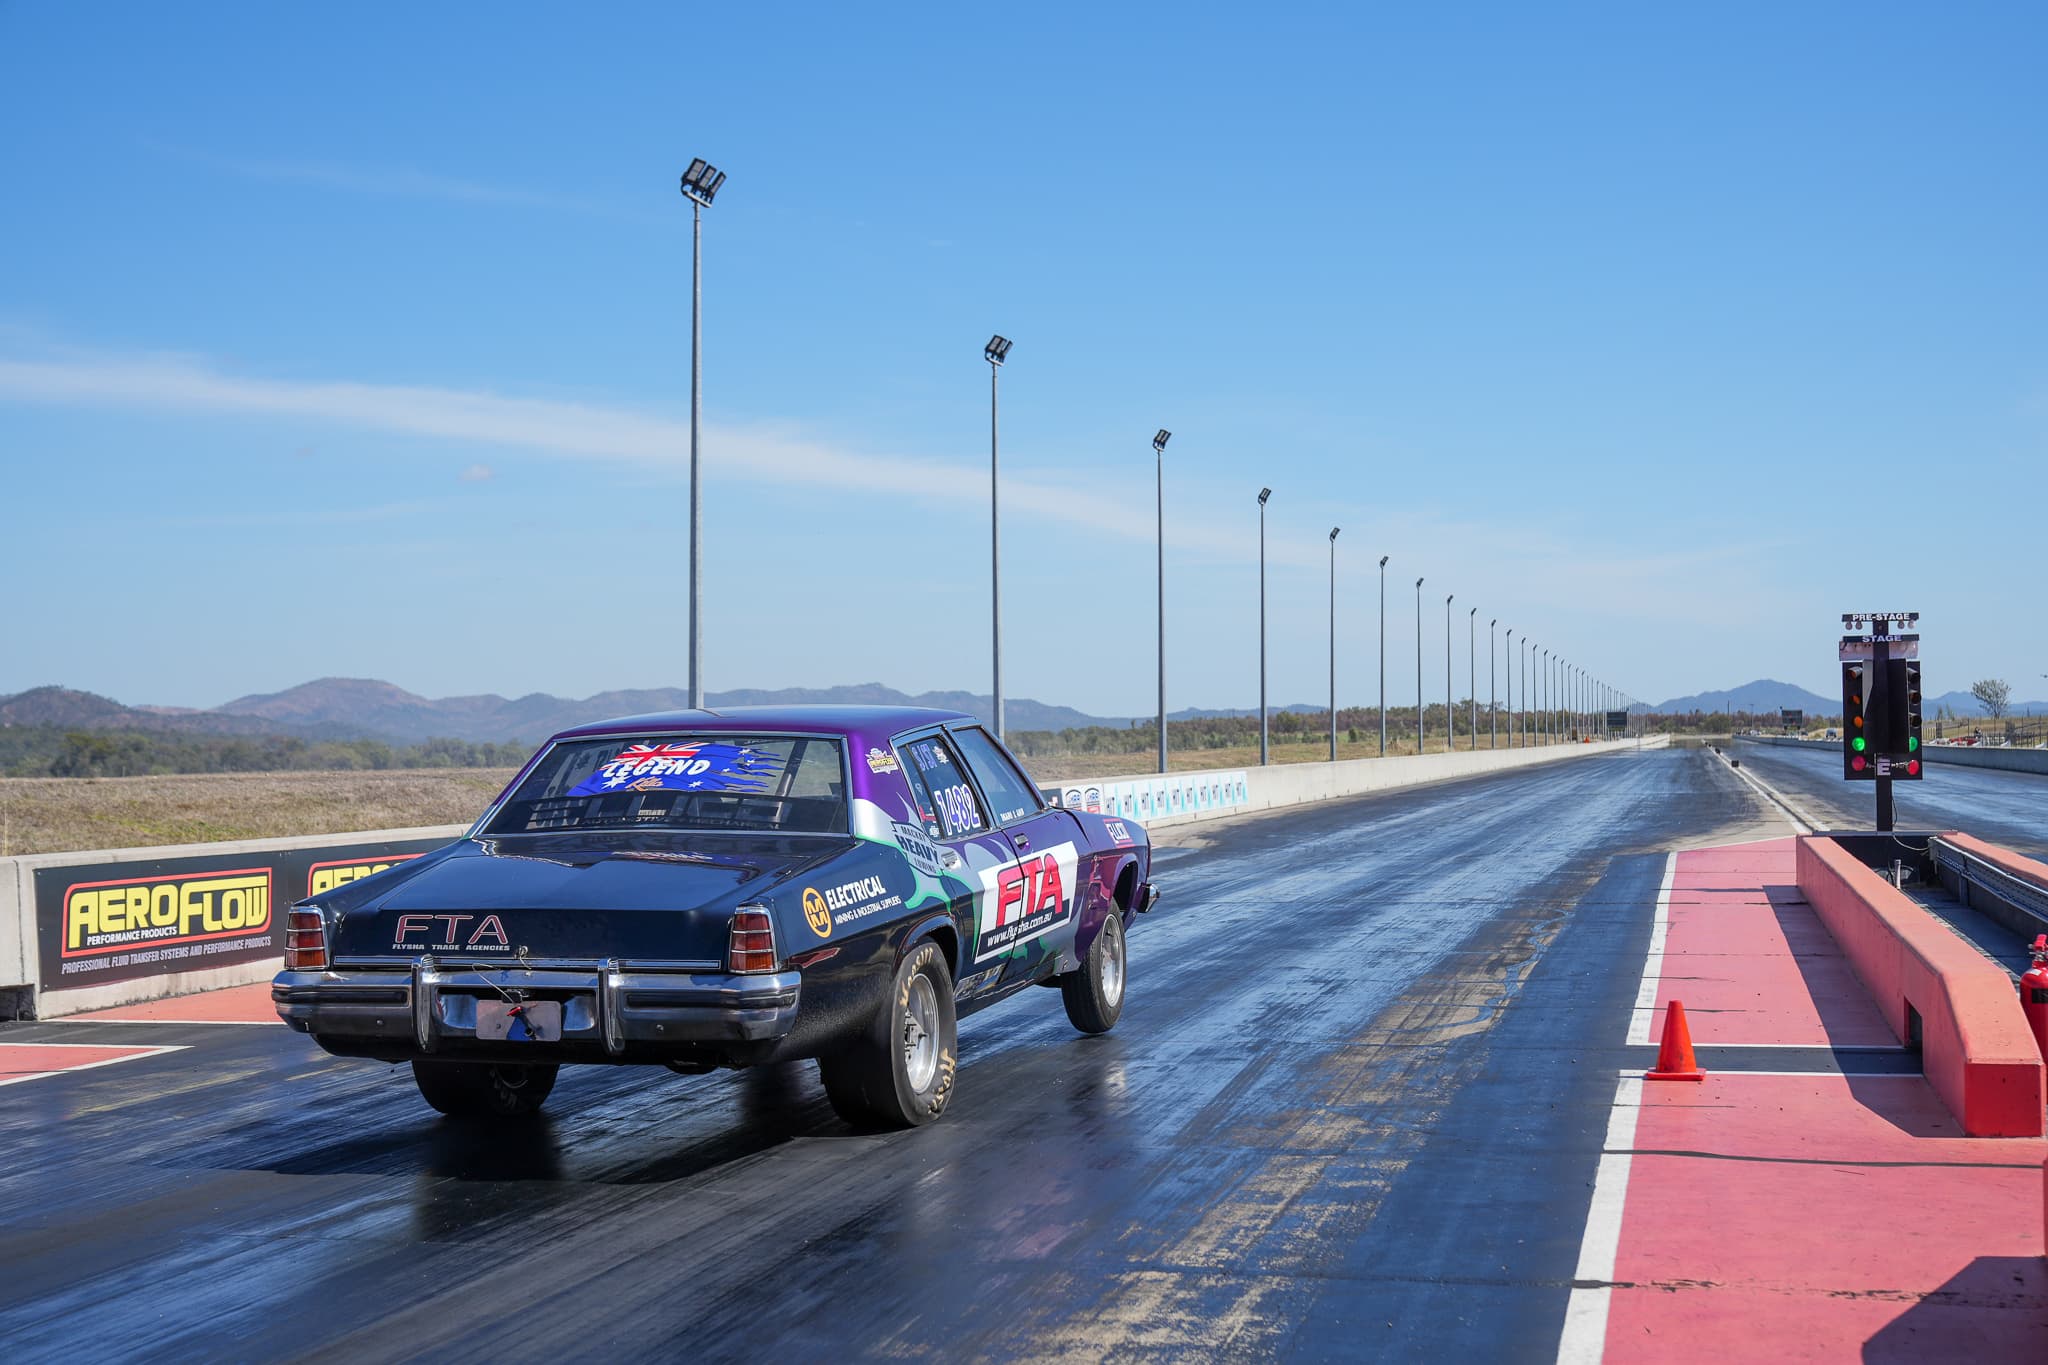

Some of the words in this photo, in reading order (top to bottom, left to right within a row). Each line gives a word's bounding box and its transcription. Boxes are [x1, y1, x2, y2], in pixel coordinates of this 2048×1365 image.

[1852, 613, 1910, 621] PRE-STAGE
[1862, 635, 1902, 643] STAGE
[602, 757, 711, 778] LEGEND
[934, 783, 981, 836] 1482
[895, 834, 939, 865] HEAVY
[825, 875, 887, 910] ELECTRICAL
[996, 853, 1063, 928] FTA
[68, 876, 268, 948] AEROFLOW
[87, 930, 141, 946] PERFORMANCE
[141, 926, 178, 940] PRODUCTS
[395, 915, 509, 944] FTA
[61, 957, 111, 975] PROFESSIONAL
[111, 954, 129, 967] FLUID
[130, 950, 160, 965] TRANSFER
[159, 947, 188, 961] SYSTEMS
[189, 944, 203, 956] AND
[203, 940, 244, 955] PERFORMANCE
[244, 936, 272, 949] PRODUCTS
[465, 944, 510, 952] AGENCIES
